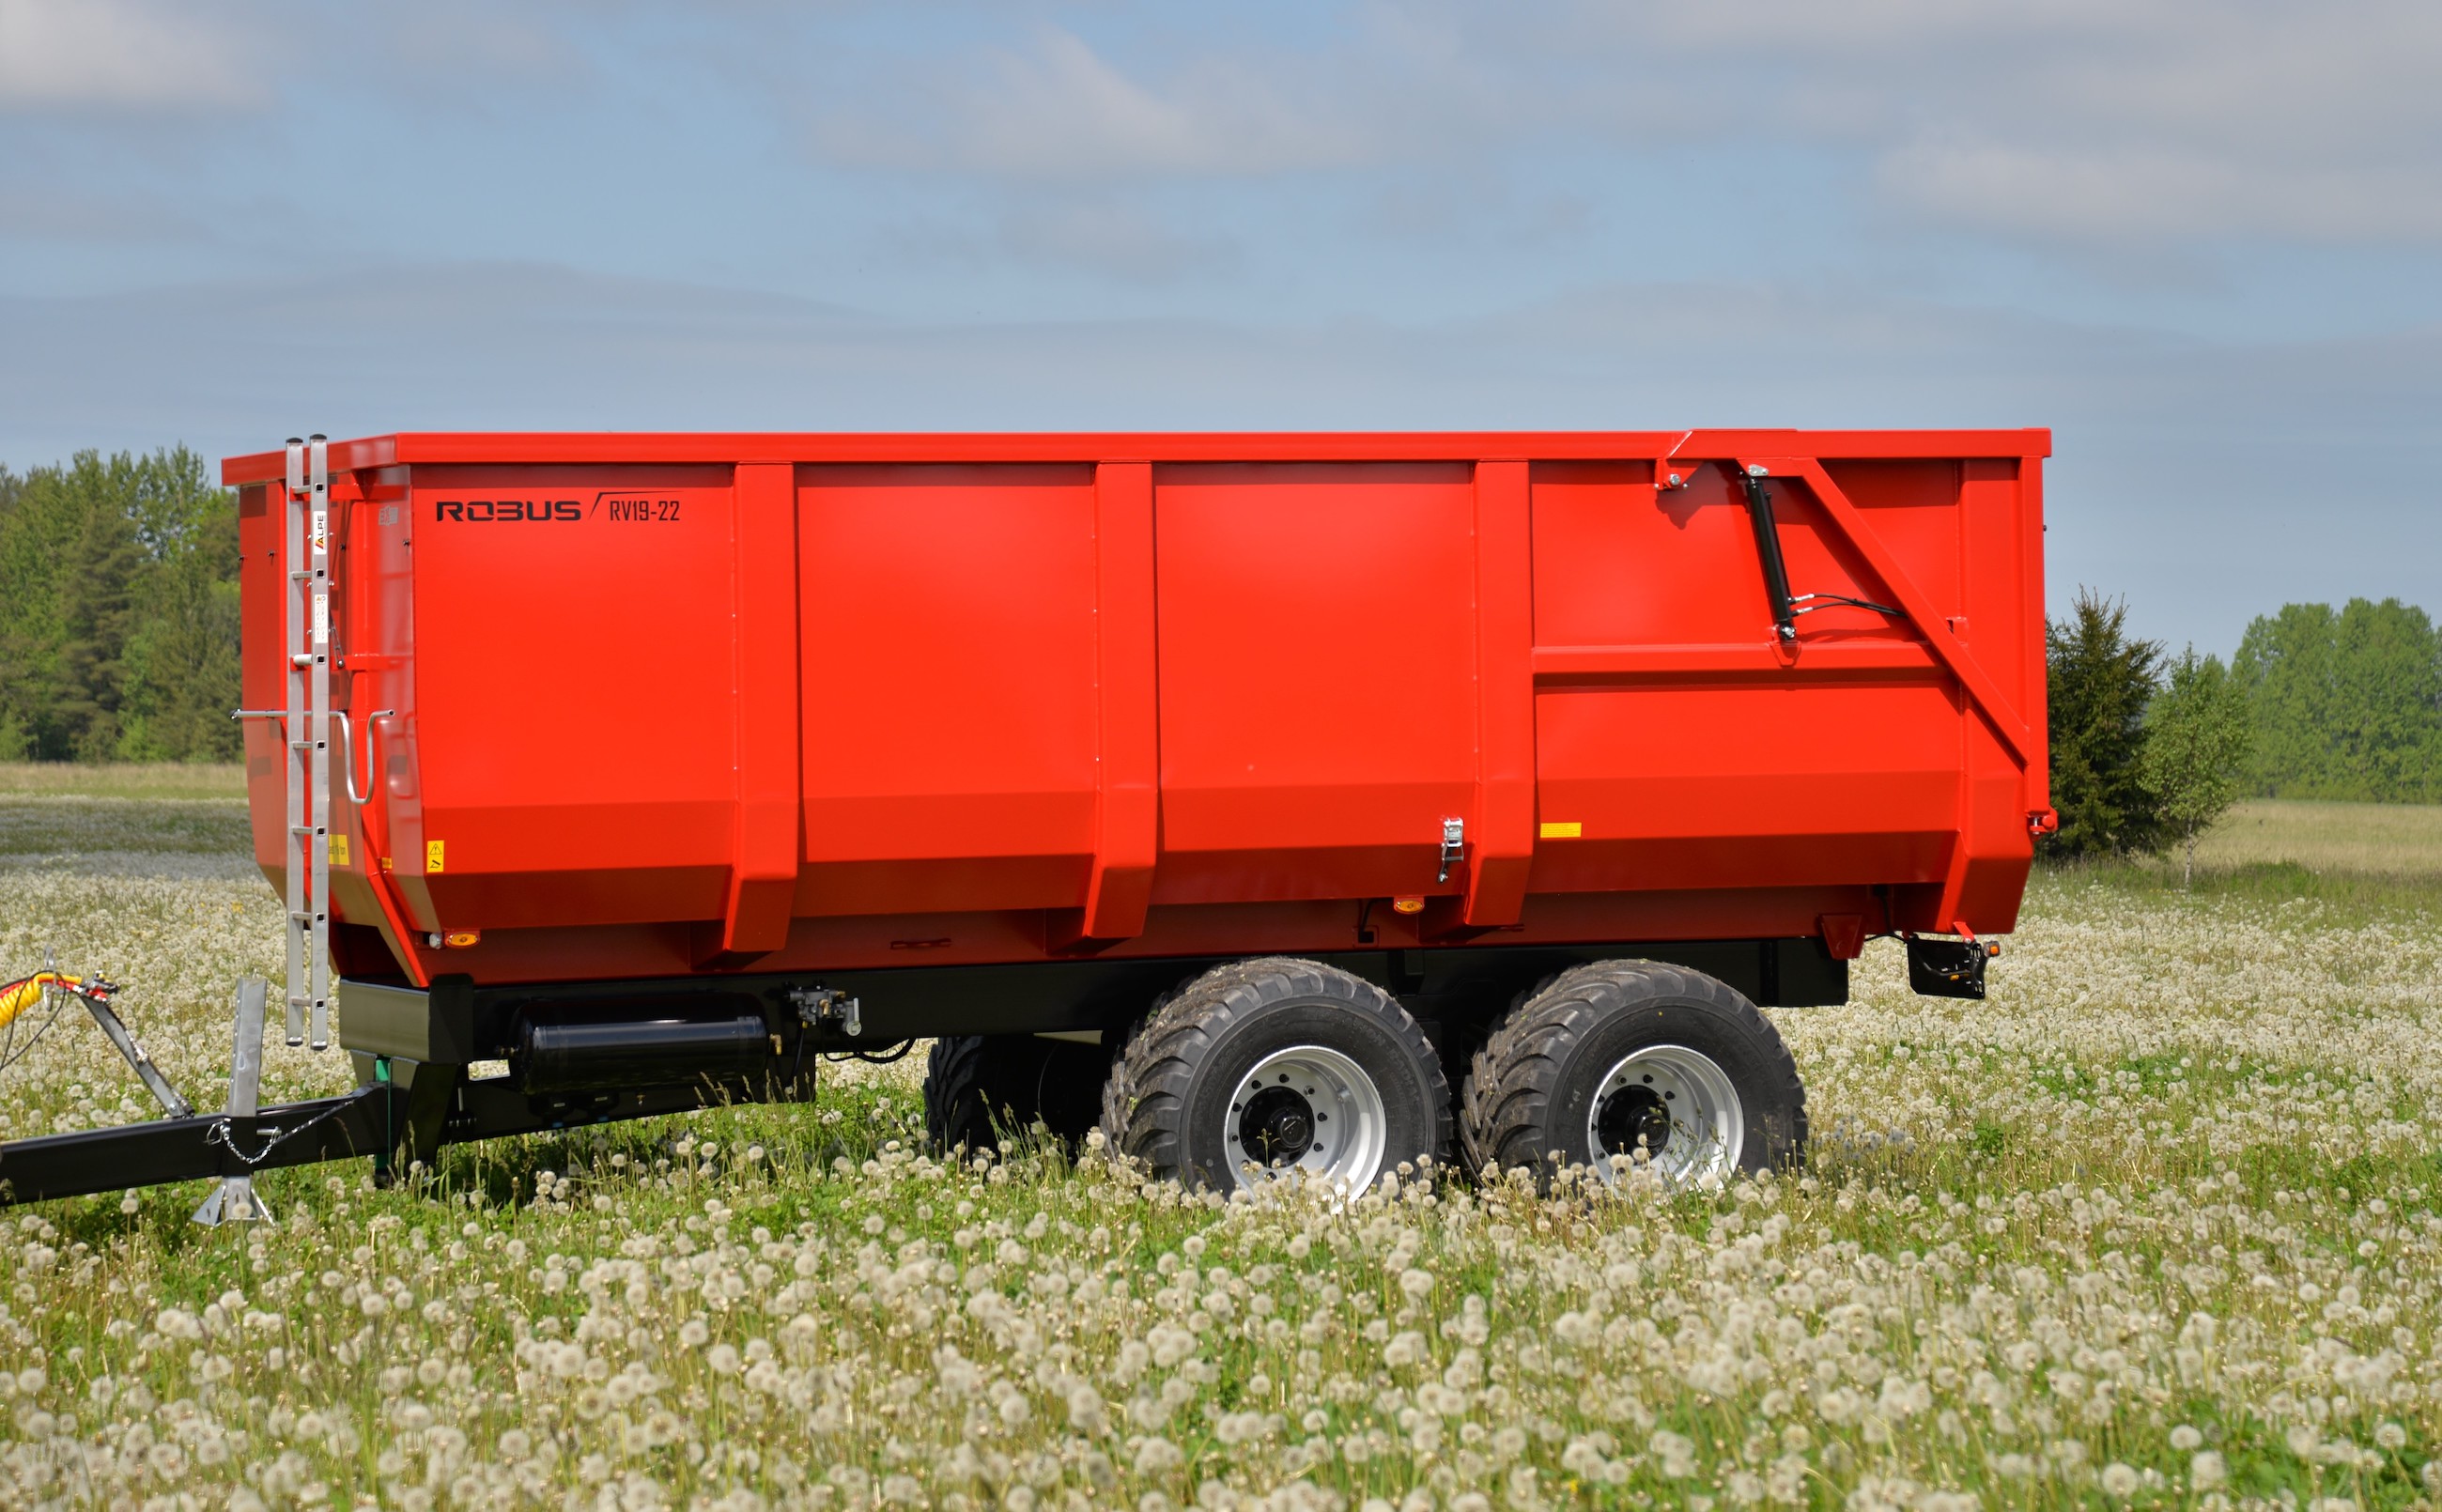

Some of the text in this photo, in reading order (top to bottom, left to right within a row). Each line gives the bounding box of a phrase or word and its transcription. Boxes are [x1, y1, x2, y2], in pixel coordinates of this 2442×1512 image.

[436, 500, 681, 522] ROBUS RV19-22
[317, 515, 325, 548] ALPE
